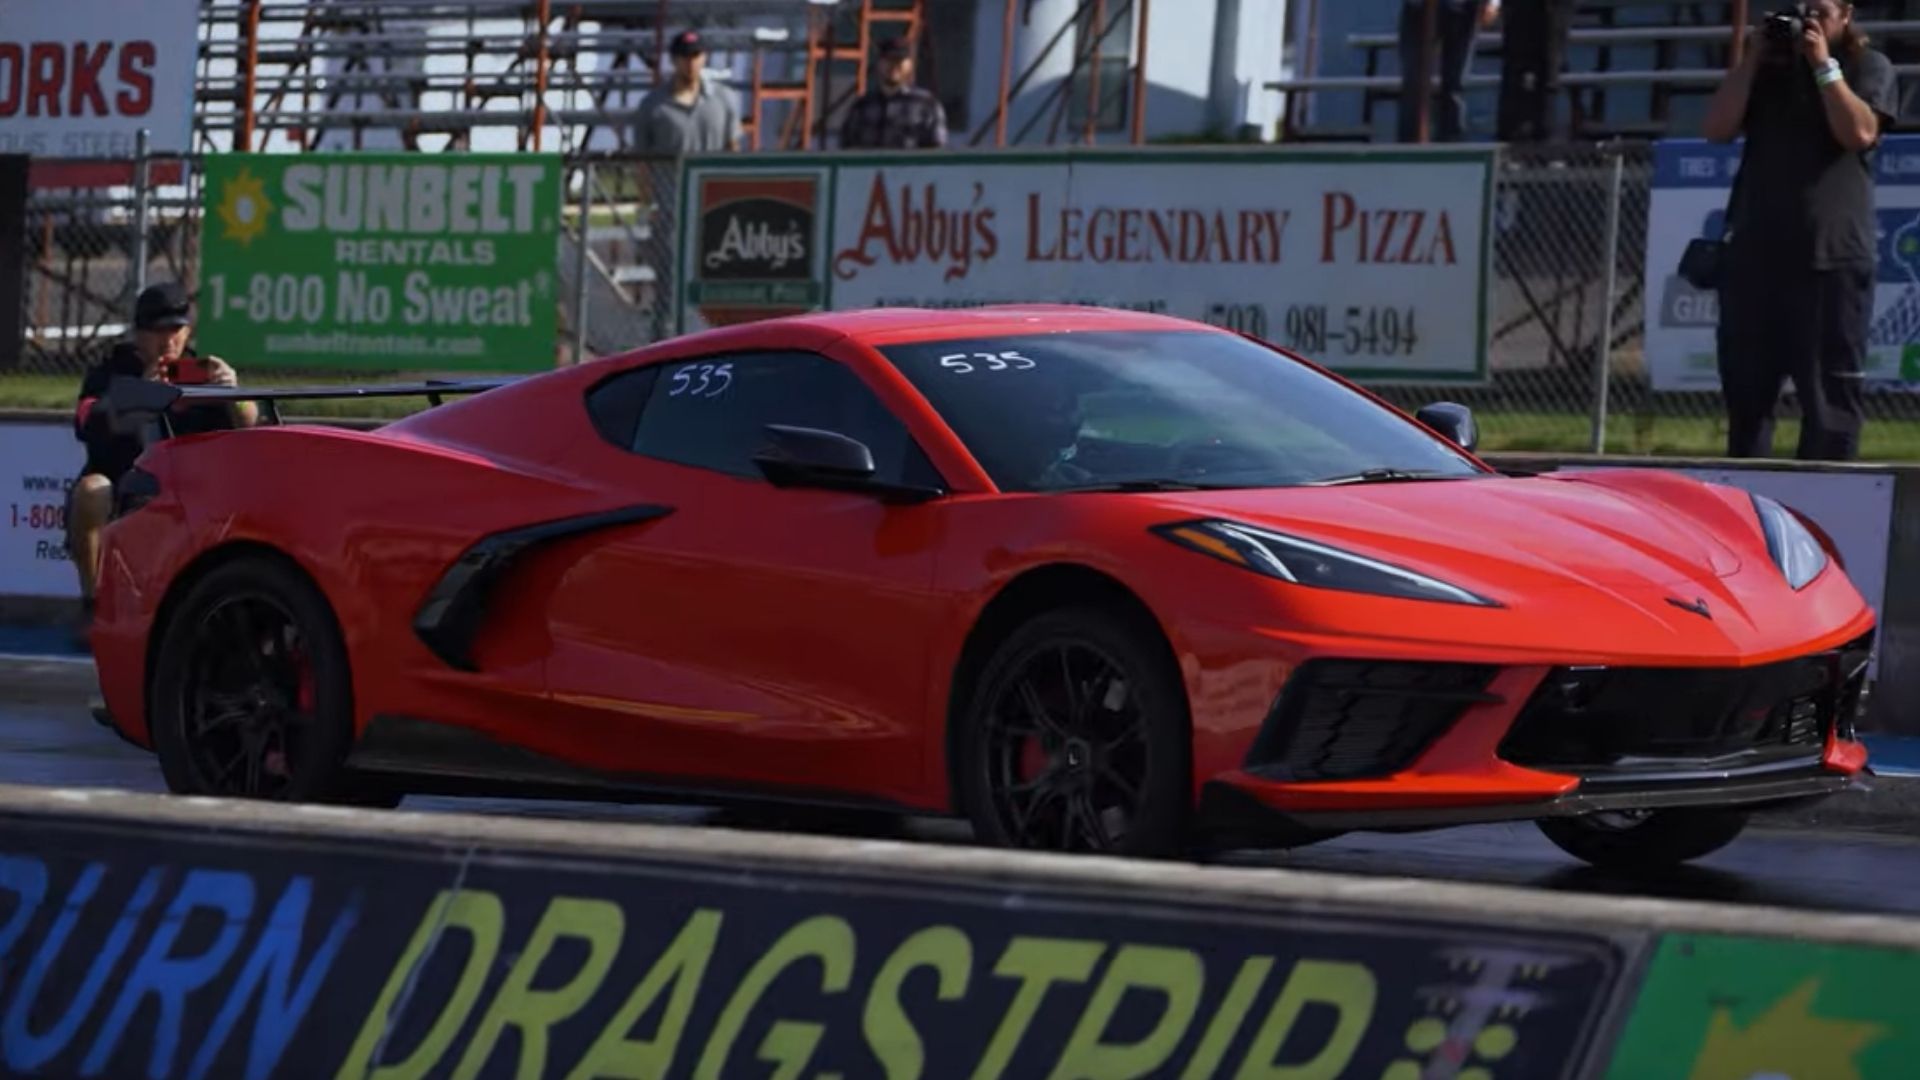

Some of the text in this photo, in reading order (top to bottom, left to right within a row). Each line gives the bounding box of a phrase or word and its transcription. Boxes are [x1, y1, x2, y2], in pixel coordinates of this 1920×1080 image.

[282, 163, 545, 233] SUNBELT
[335, 239, 496, 265] RENTALS
[705, 213, 806, 271] Abby's
[832, 169, 1458, 283] Abby's LEGENDARY PIZZA
[209, 272, 325, 324] 1-800
[336, 271, 391, 325] No
[1284, 303, 1419, 356] 981-5494
[669, 363, 734, 398] 535
[940, 351, 1036, 374] 535
[334, 888, 1378, 1080] DRAGSTRIP
